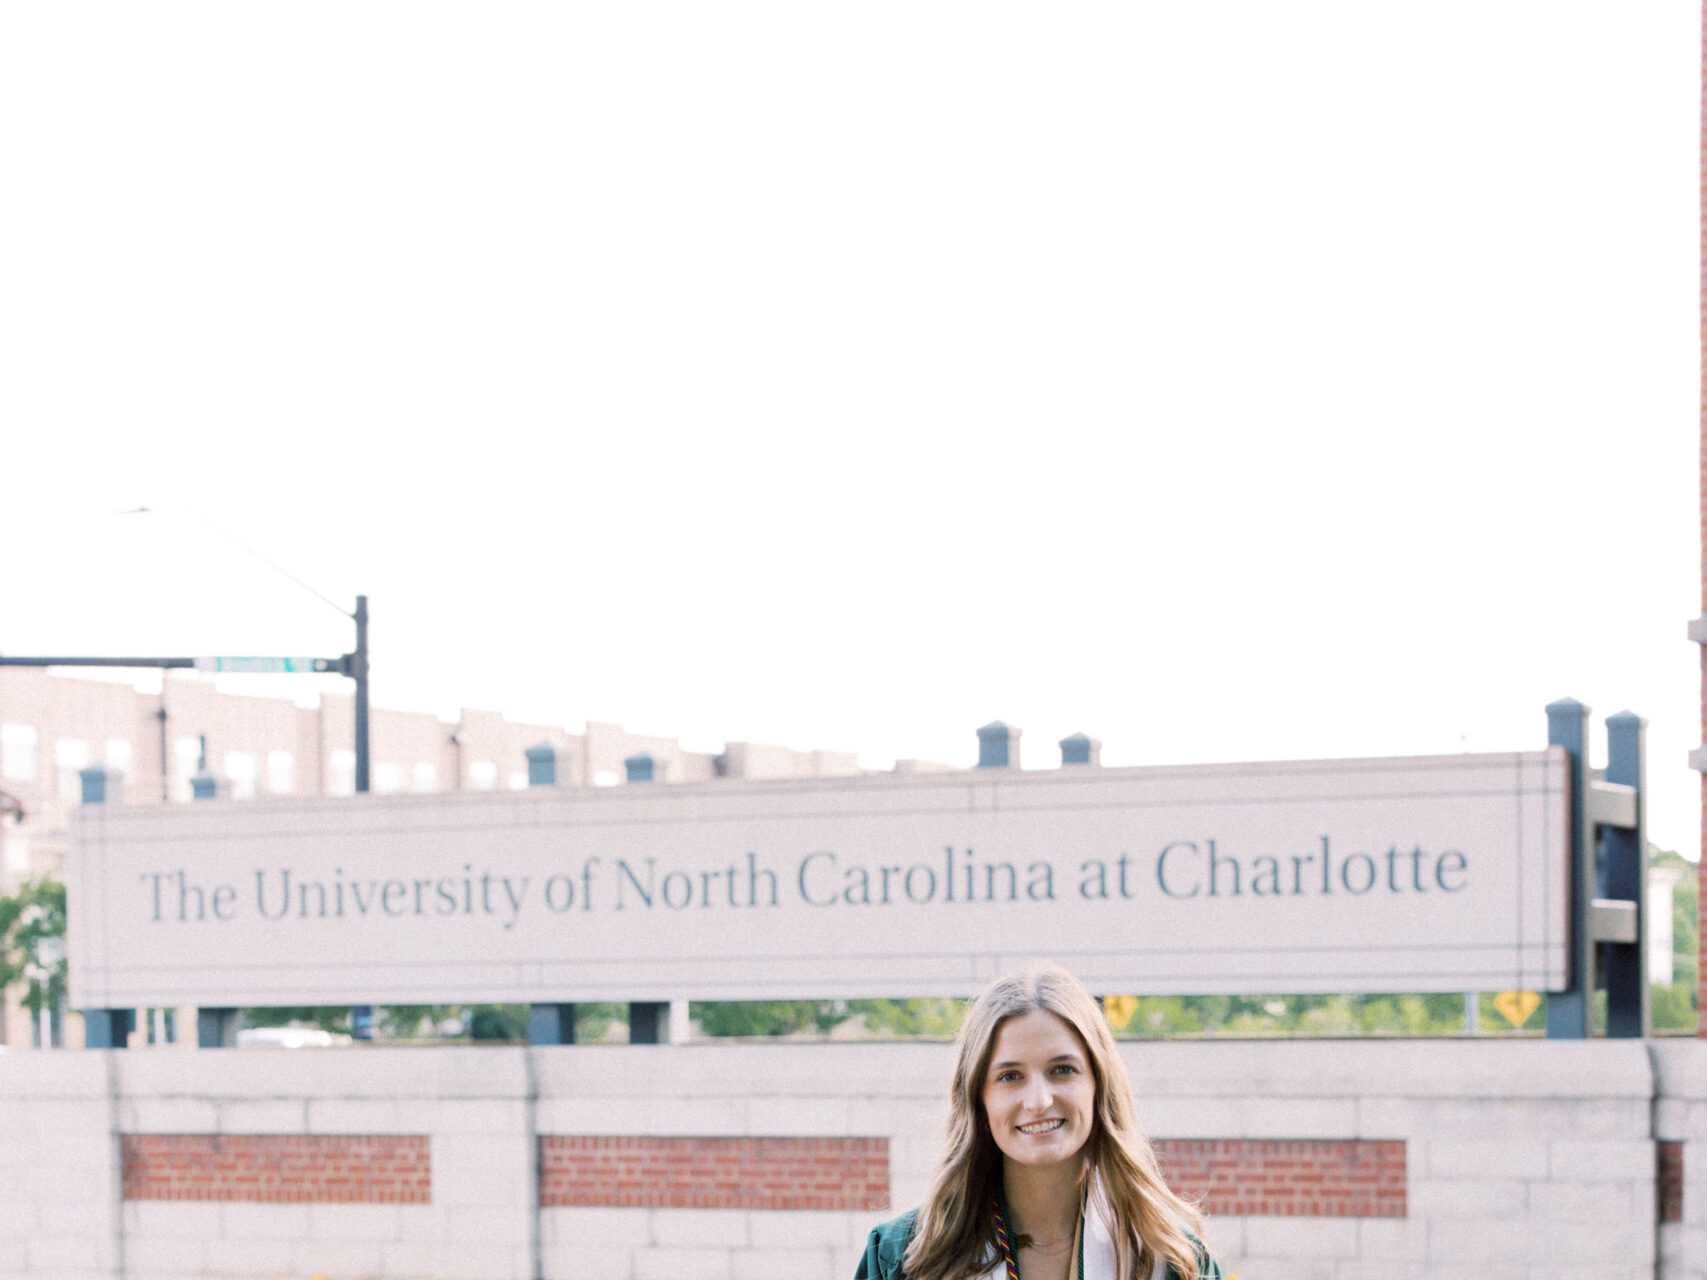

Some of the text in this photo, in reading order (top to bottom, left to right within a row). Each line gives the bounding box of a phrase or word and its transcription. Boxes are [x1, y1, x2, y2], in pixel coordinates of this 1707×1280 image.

[139, 835, 1470, 931] The University of North Carolina at Charlotte
